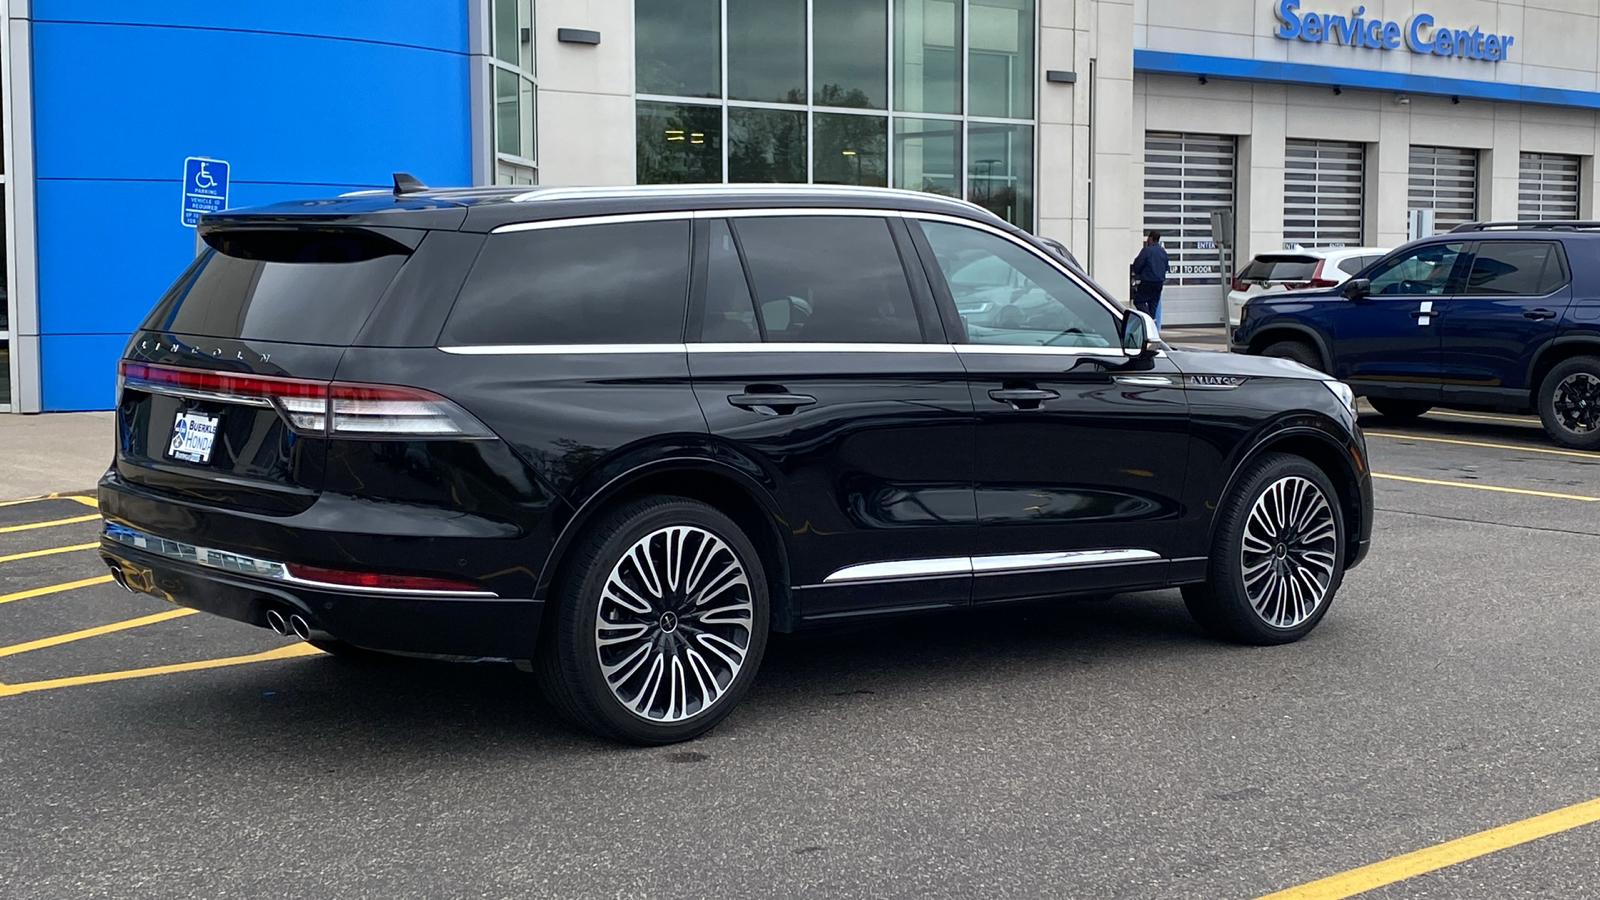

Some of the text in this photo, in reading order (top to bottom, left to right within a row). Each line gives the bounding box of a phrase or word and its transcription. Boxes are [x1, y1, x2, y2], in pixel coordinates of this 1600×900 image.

[1274, 0, 1514, 61] Service Center
[1193, 266, 1212, 274] DOOR
[142, 340, 270, 362] LINCOLN
[1190, 376, 1238, 385] AVIATOR
[189, 420, 216, 434] BUERKLE
[185, 431, 213, 450] HONDA
